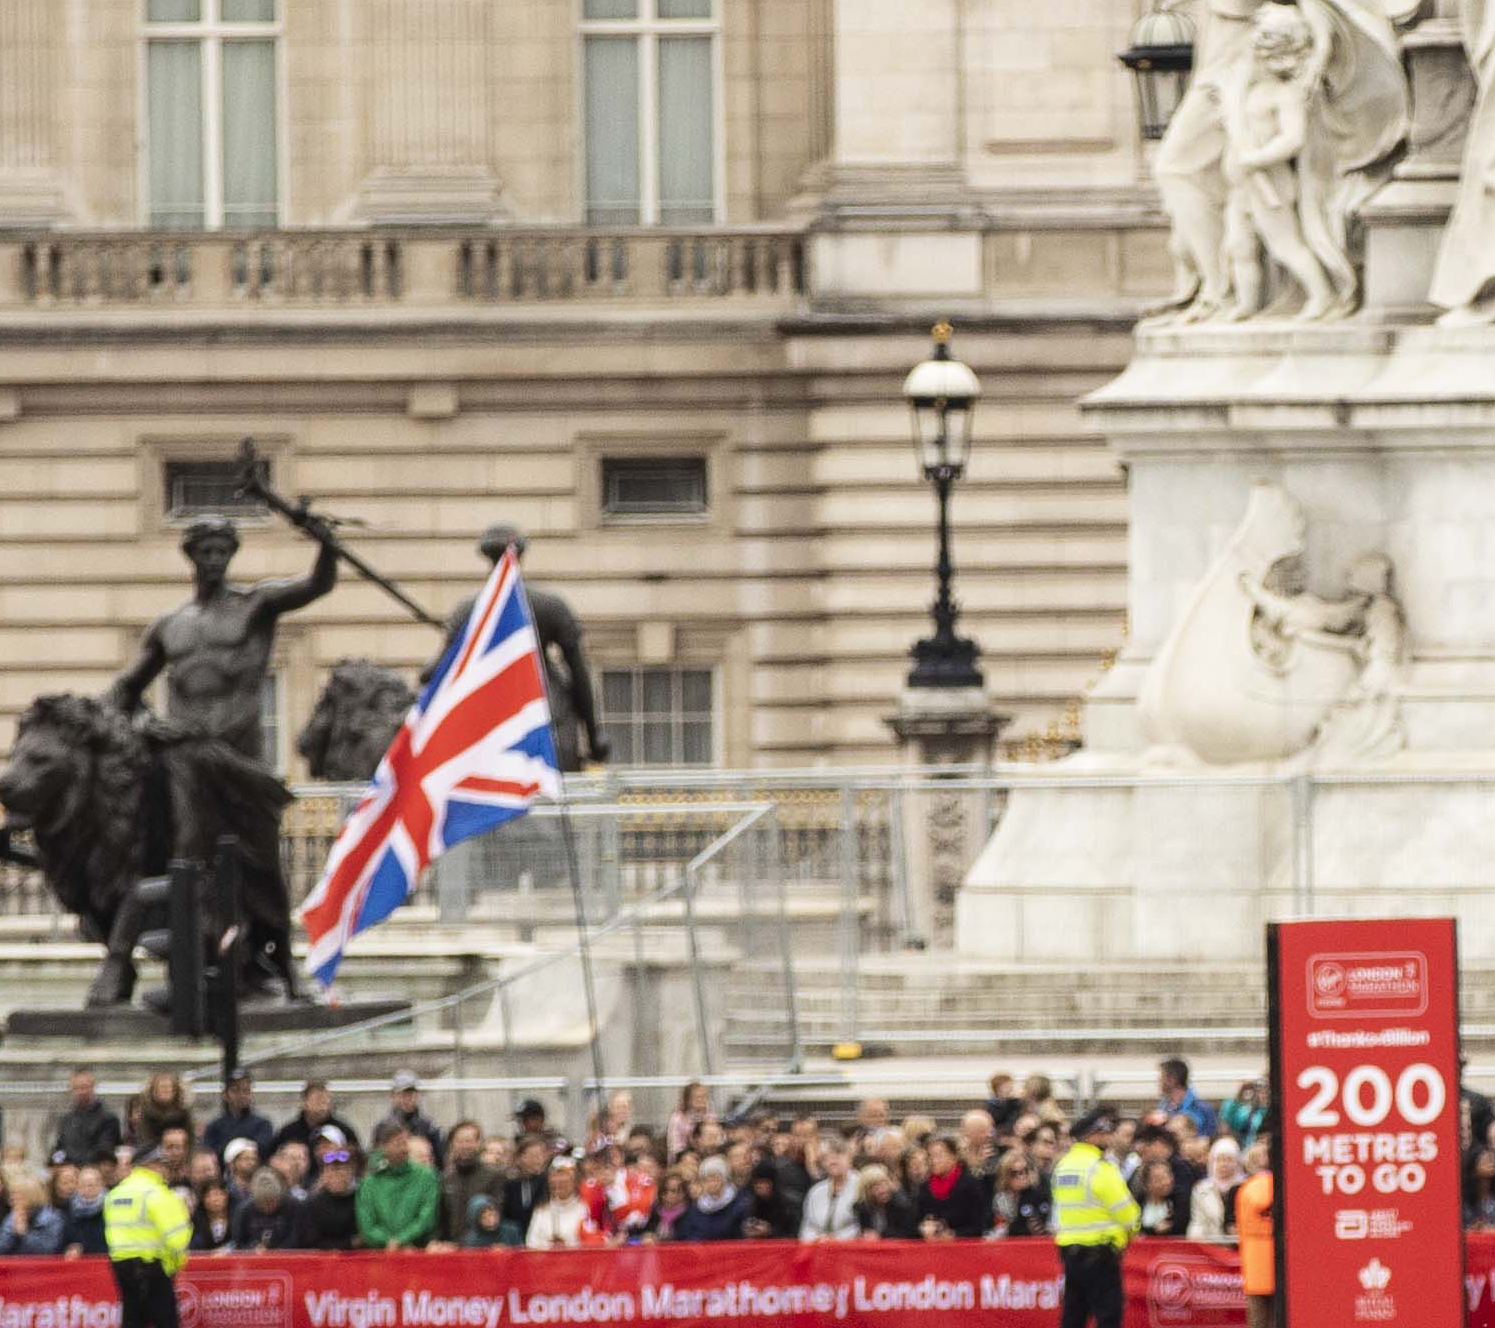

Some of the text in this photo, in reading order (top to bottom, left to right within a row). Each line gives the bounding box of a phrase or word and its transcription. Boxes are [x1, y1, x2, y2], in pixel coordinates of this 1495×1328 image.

[1296, 1063, 1446, 1128] 200
[1304, 1131, 1439, 1165] METRES
[1315, 1163, 1427, 1195] TO GO
[507, 1285, 635, 1324] London
[852, 1274, 975, 1312] London
